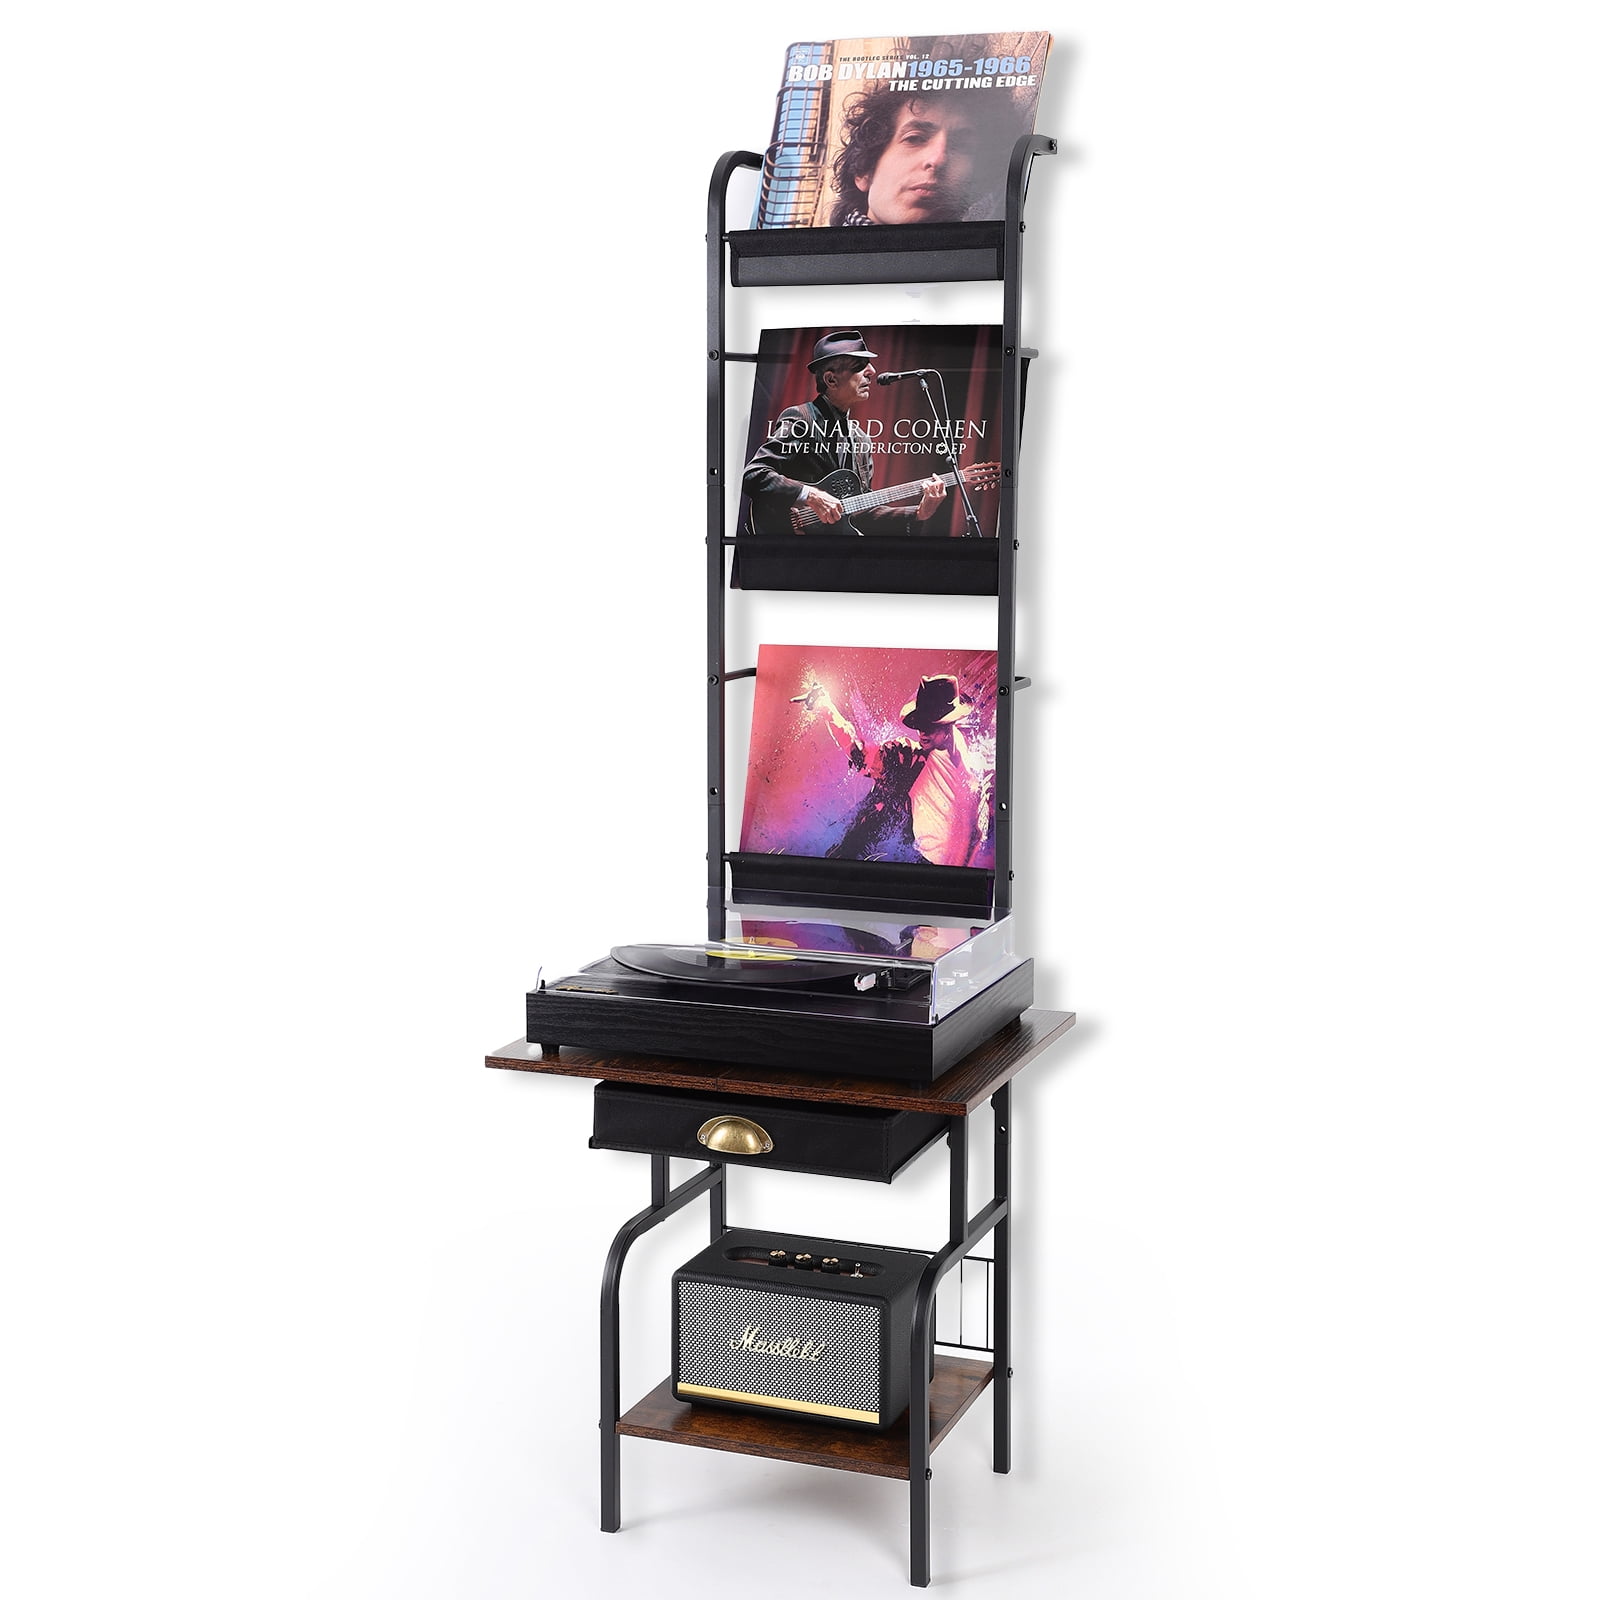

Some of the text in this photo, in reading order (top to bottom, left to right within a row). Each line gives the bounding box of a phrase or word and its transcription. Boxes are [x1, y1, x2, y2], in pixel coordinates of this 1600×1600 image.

[788, 55, 1032, 82] BOB DYLAN 1965-1966
[889, 74, 1038, 92] THE CUTTING EDGE
[766, 418, 987, 439] LEONARD COHEN
[781, 442, 967, 455] LIVE IN FREDERICTON EP
